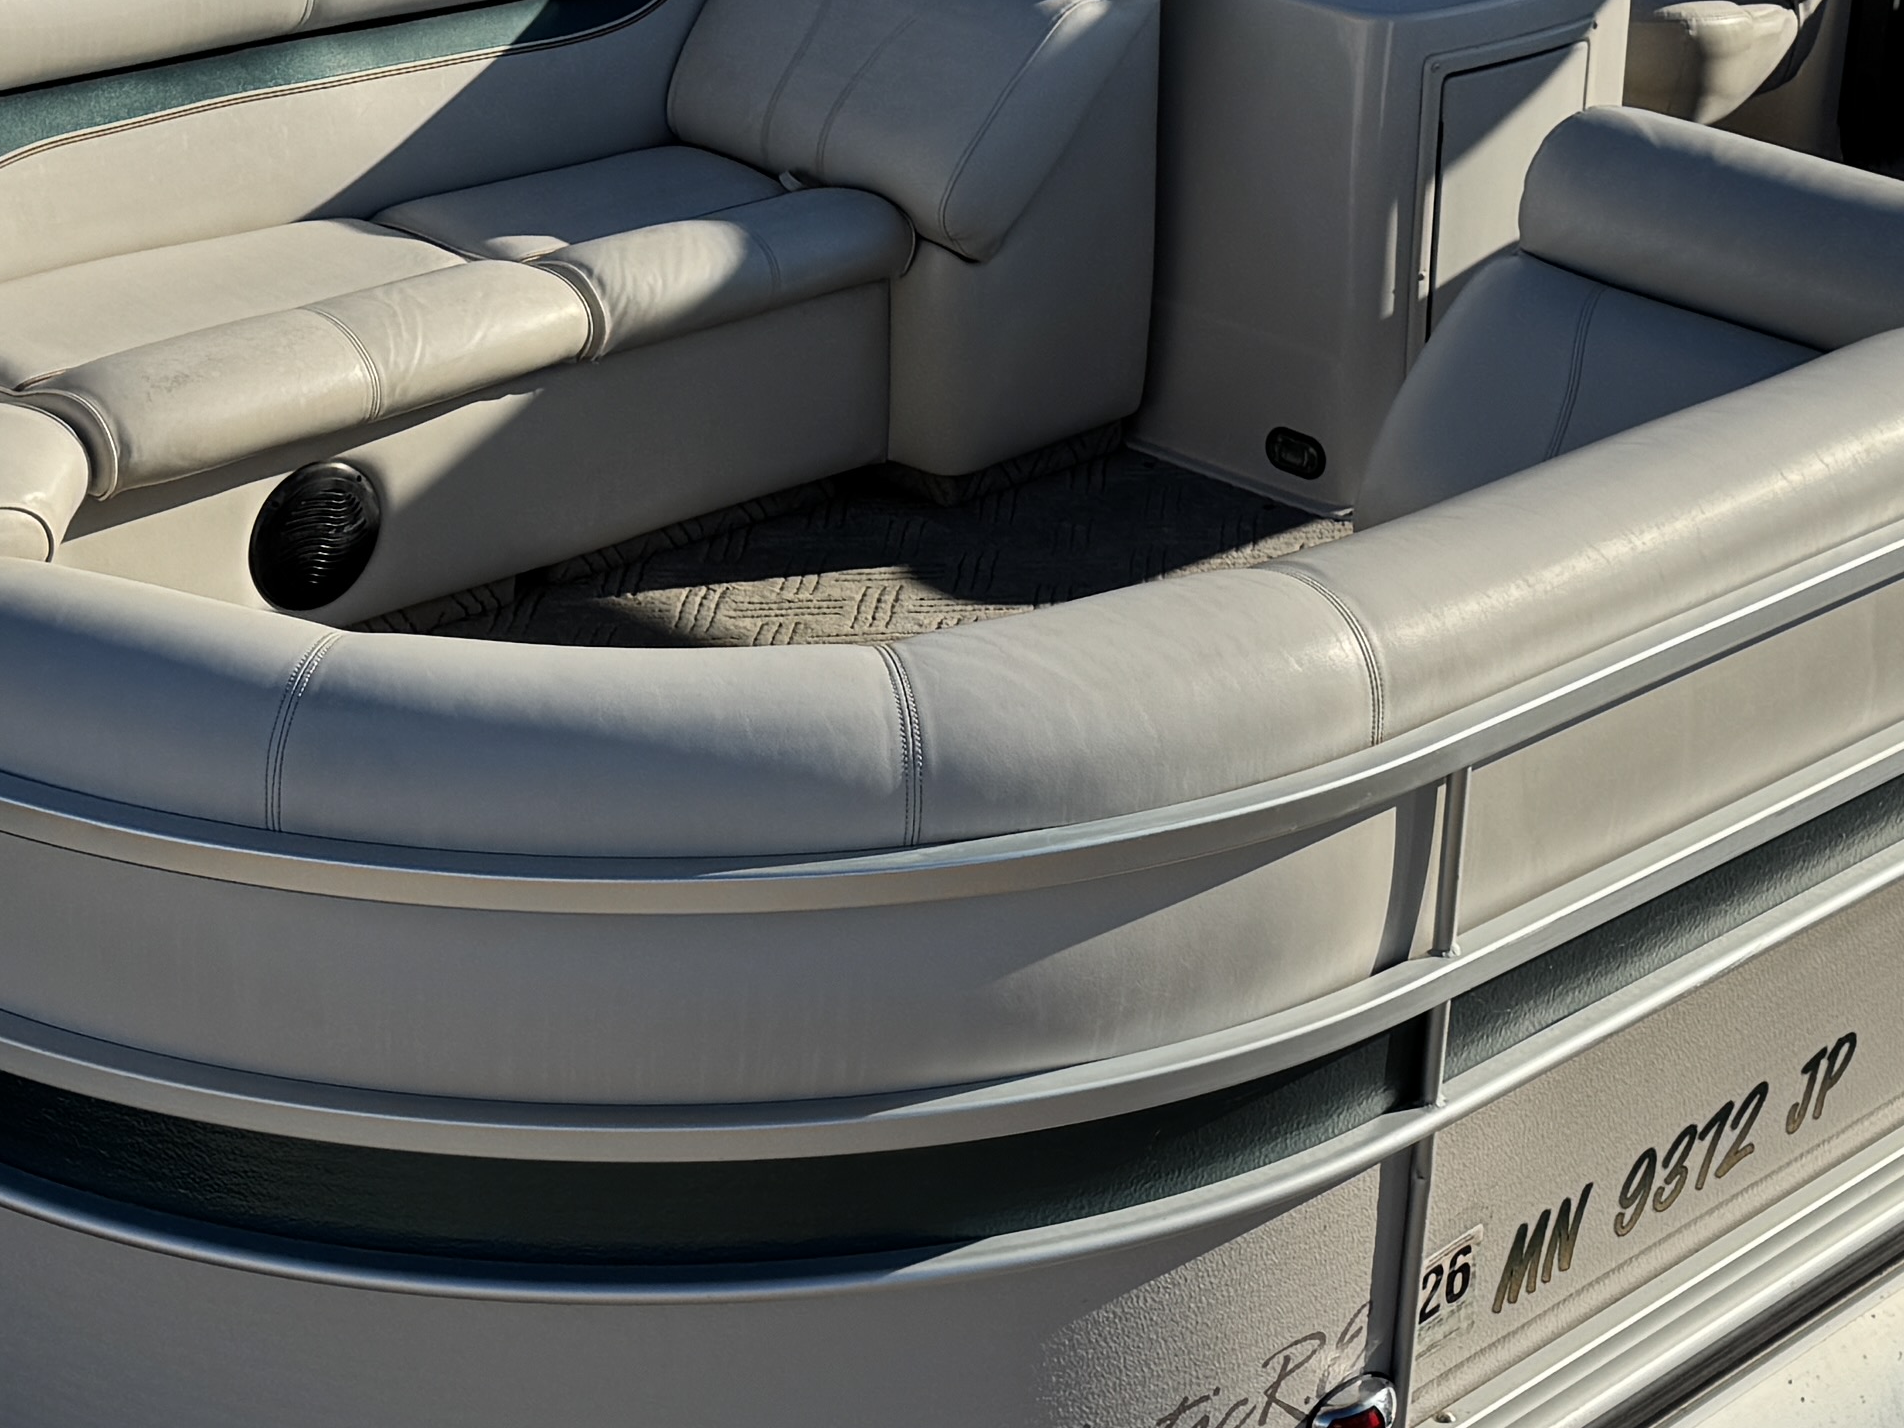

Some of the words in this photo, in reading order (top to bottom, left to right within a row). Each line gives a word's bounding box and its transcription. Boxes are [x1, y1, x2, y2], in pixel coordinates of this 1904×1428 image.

[1492, 1182, 1594, 1313] MN
[1614, 1081, 1769, 1237] 9372
[1785, 1031, 1857, 1135] JP
[1418, 1244, 1472, 1325] 26
